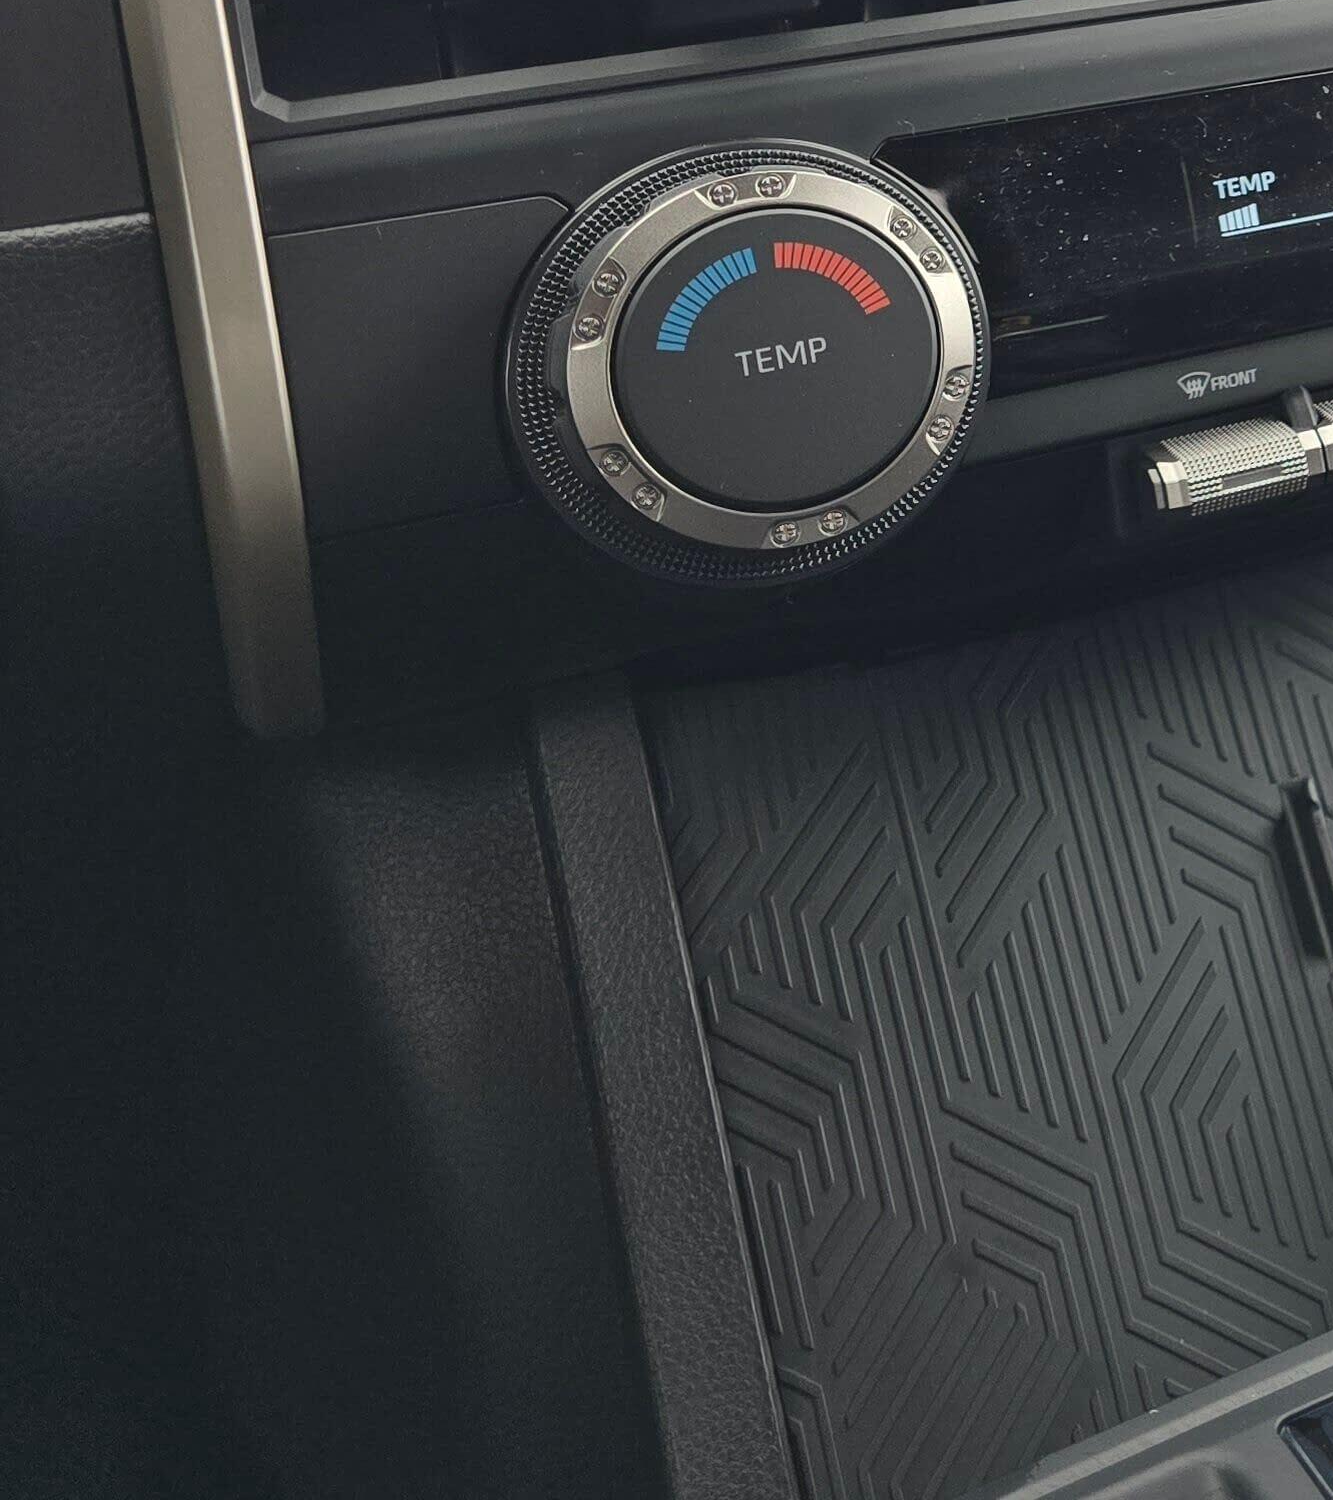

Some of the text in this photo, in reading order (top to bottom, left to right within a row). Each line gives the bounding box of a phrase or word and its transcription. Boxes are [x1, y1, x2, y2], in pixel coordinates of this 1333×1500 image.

[1213, 170, 1276, 200] TEMP
[735, 336, 828, 377] TEMP
[1211, 367, 1257, 392] FRONT
